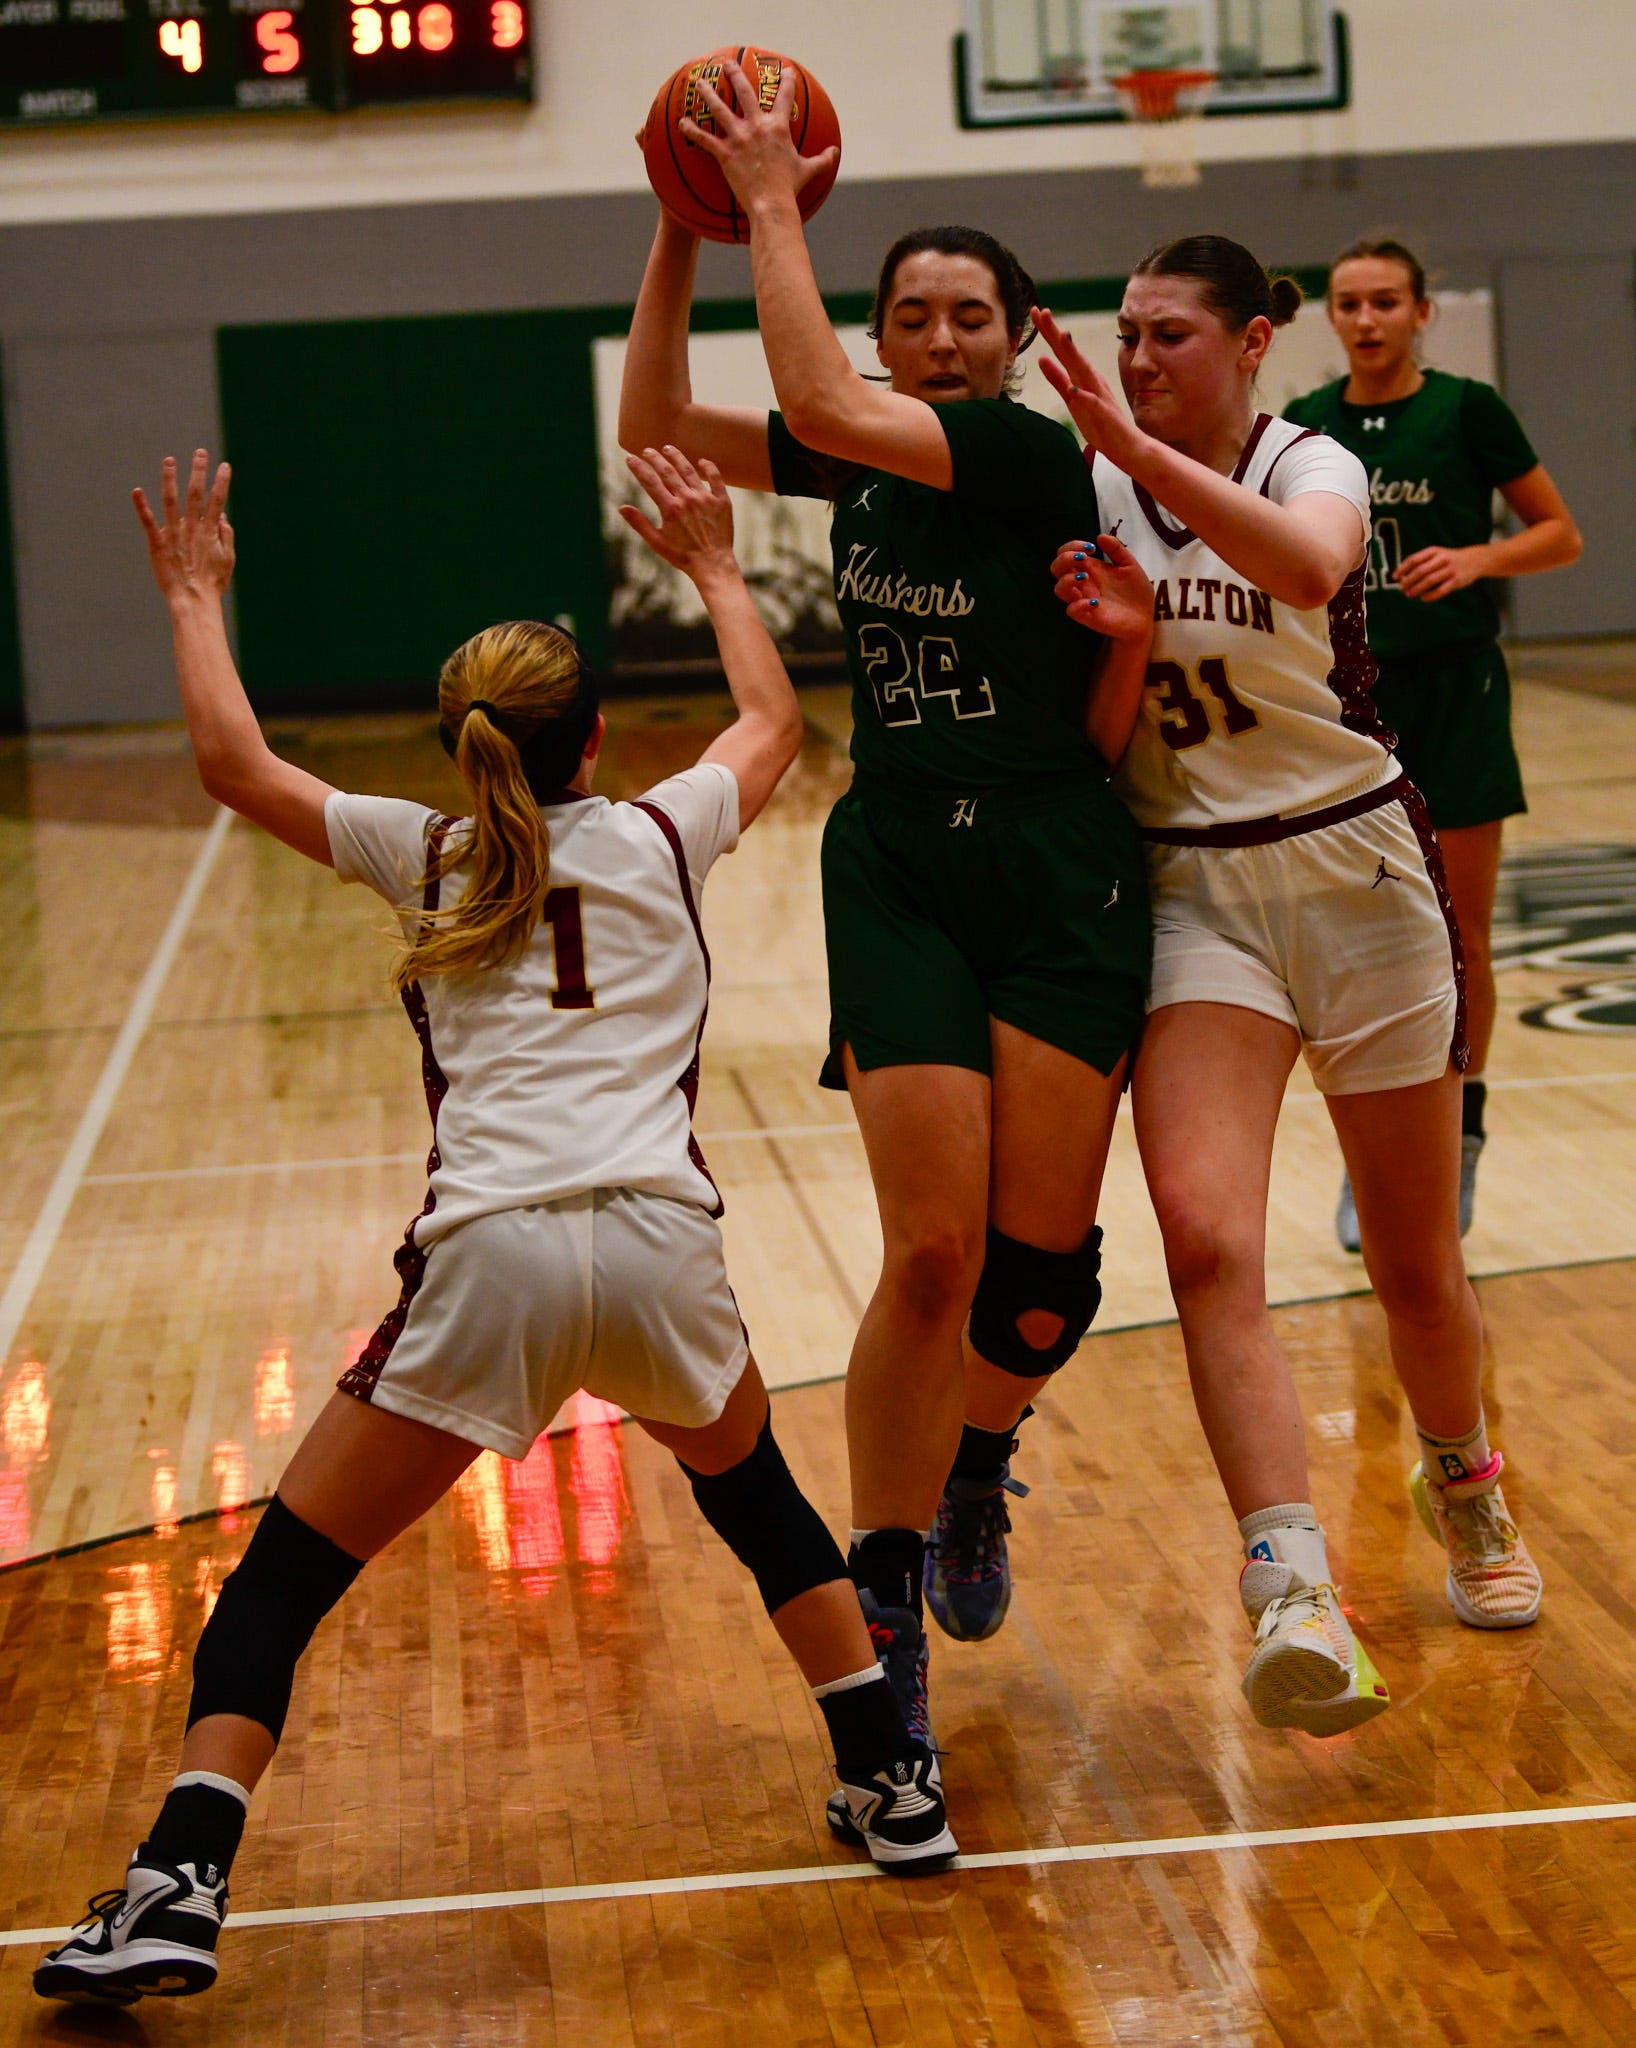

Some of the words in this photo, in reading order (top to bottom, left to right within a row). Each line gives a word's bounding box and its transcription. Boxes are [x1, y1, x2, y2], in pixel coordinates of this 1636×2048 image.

[158, 19, 202, 73] 4
[256, 9, 300, 73] 5
[1369, 466, 1435, 505] kers
[837, 542, 976, 617] Huskers
[1150, 578, 1275, 635] ALTON
[858, 622, 997, 728] 24
[1144, 654, 1263, 756] 31
[539, 883, 598, 1013] 1
